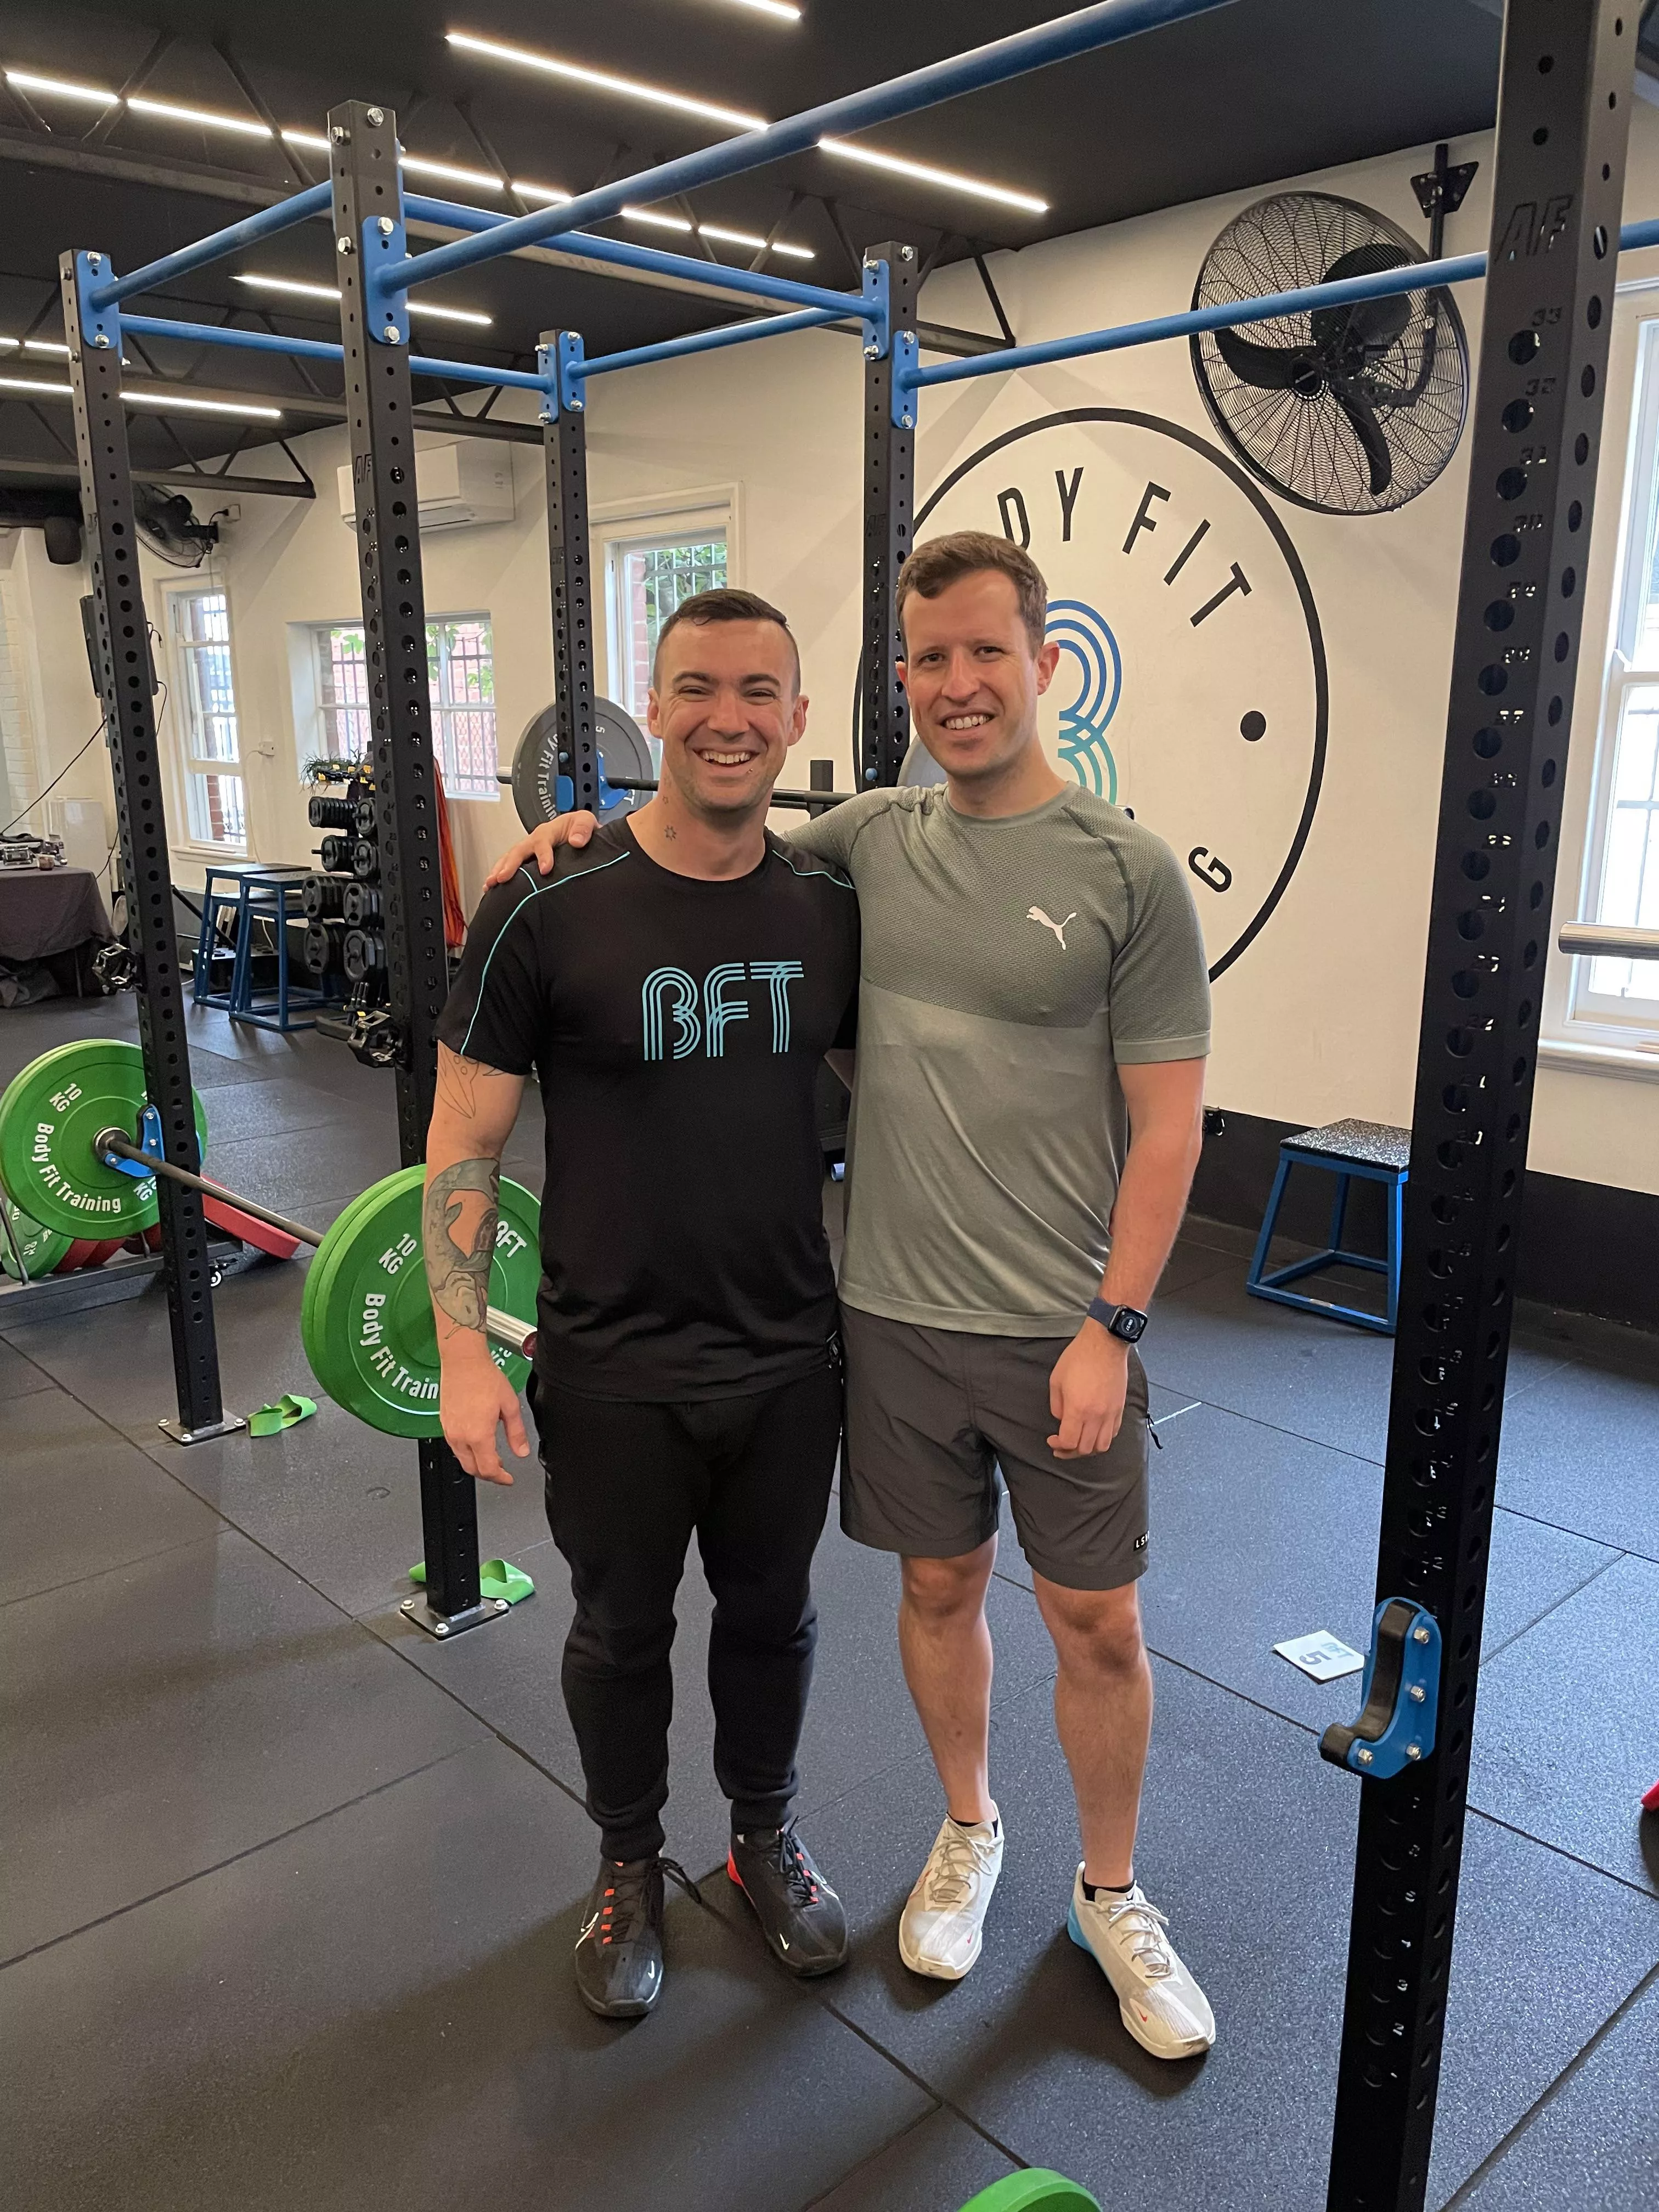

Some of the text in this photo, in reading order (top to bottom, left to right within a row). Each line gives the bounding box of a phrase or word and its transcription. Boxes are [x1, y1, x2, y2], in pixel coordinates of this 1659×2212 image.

[997, 466, 1252, 628] DY FIT
[539, 750, 554, 769] Fit
[538, 772, 557, 821] Trainin
[641, 961, 804, 1061] BFT
[49, 1092, 70, 1112] KG
[64, 1083, 82, 1101] 10
[32, 1122, 122, 1214] Body Fit Training
[396, 1233, 417, 1256] 10
[379, 1248, 404, 1275] KG
[360, 1293, 439, 1399] Body Fit Train
[1299, 1650, 1333, 1665] 5
